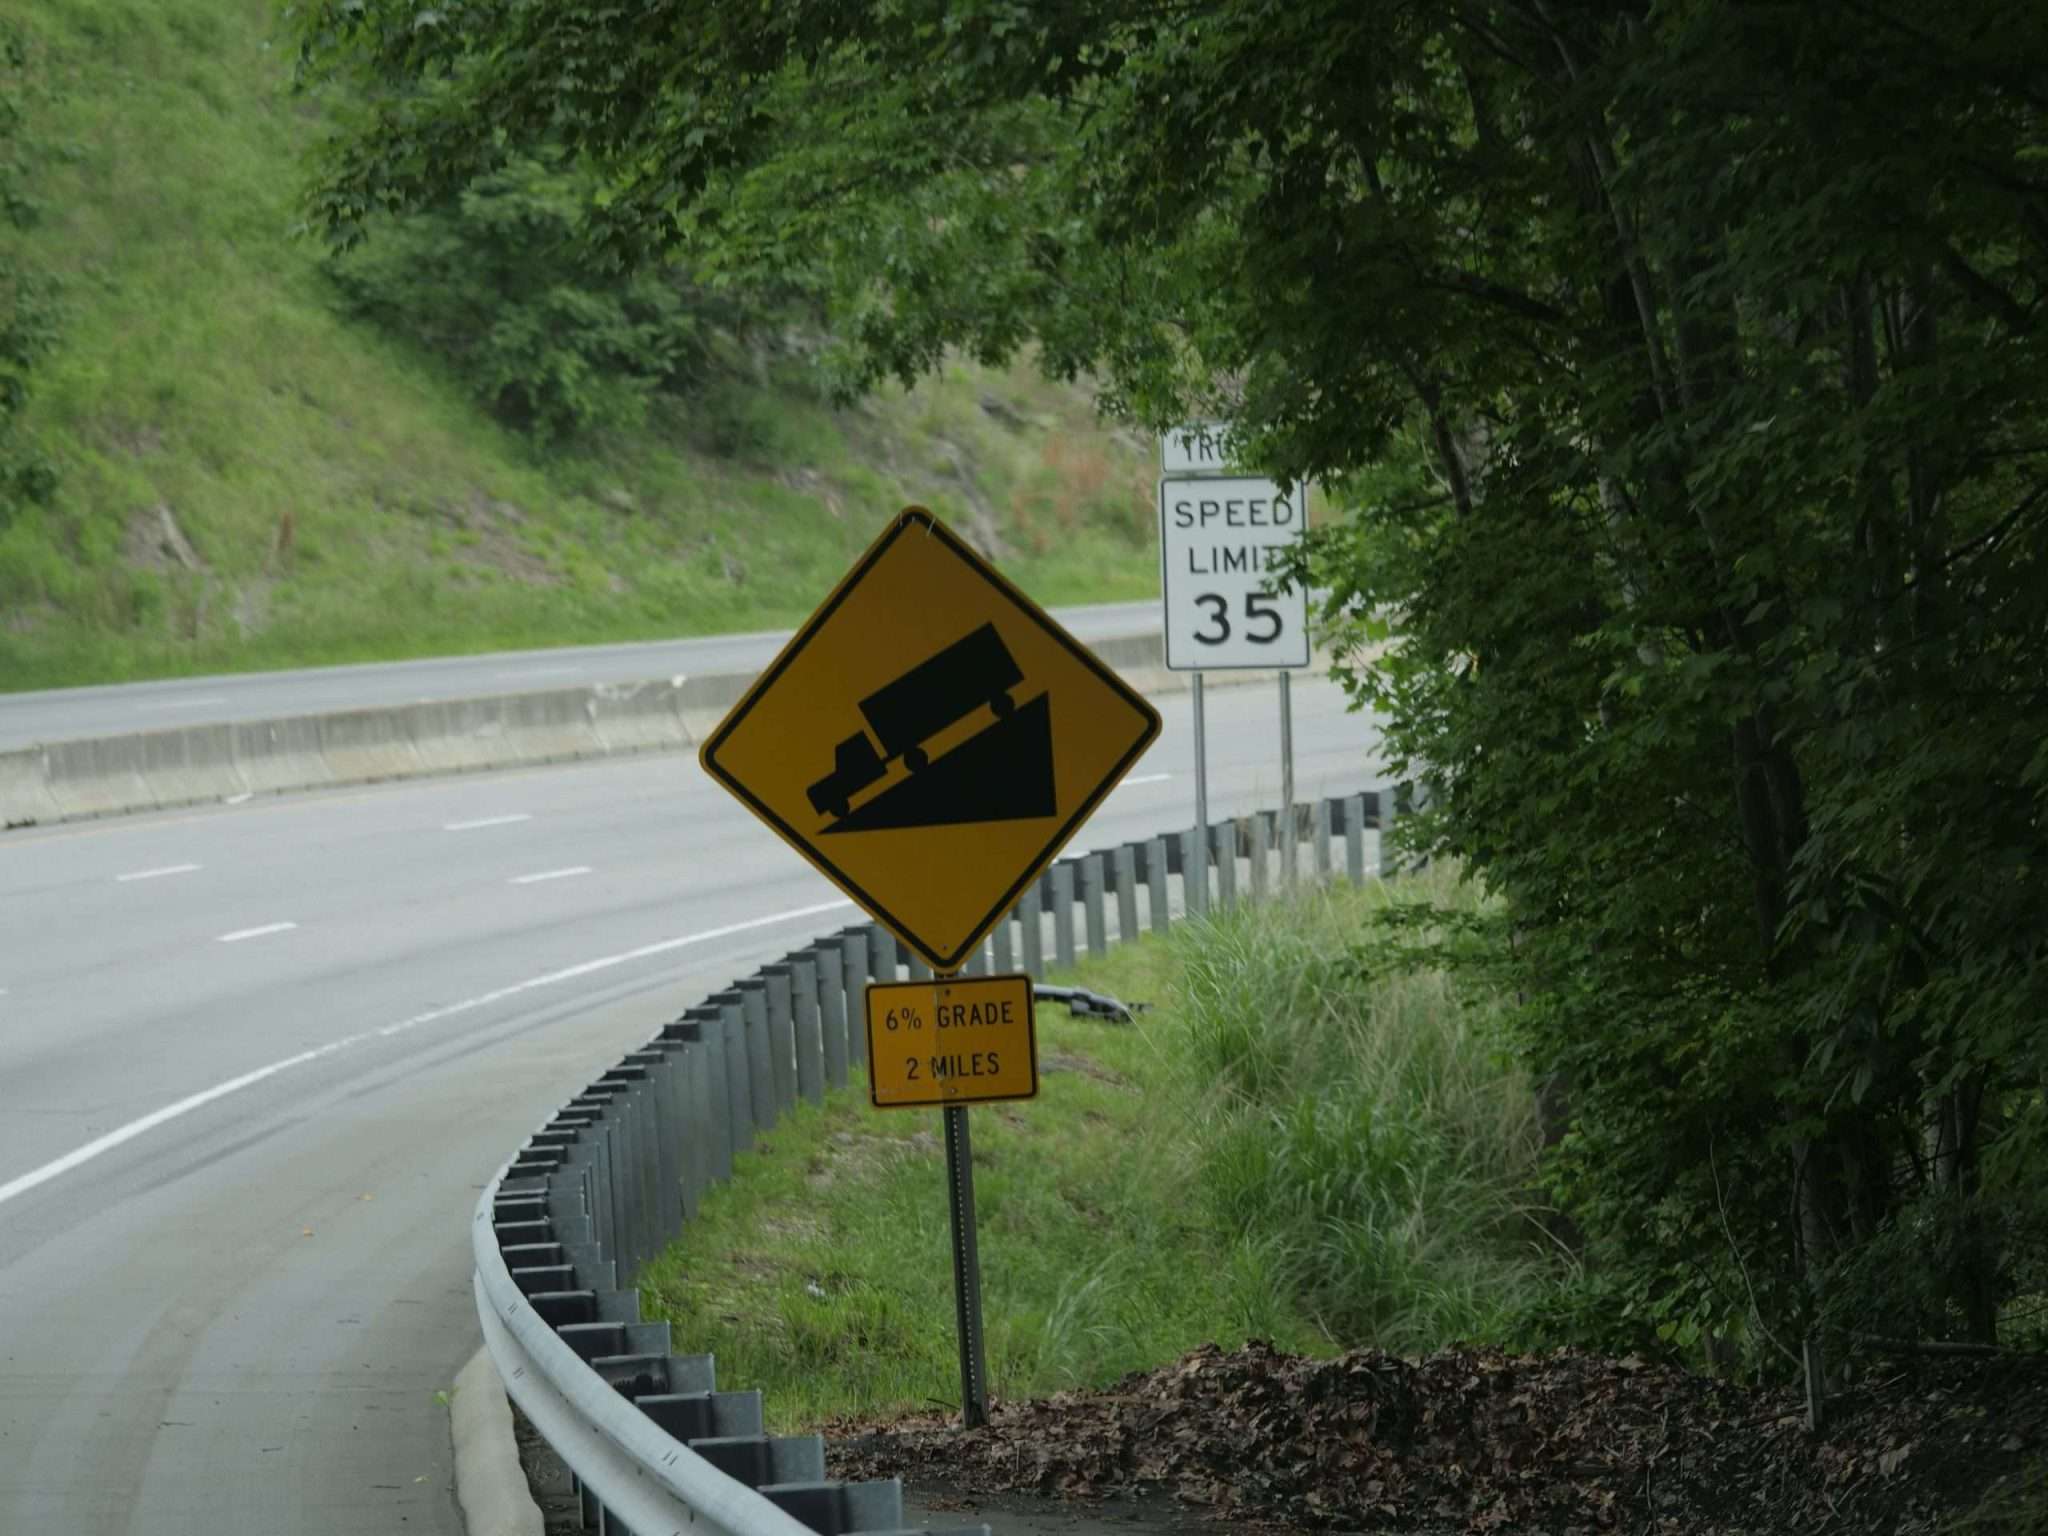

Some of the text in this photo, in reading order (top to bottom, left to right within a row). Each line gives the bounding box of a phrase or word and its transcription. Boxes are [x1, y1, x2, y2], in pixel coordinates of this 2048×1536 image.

[1175, 500, 1293, 528] SPEED
[1193, 593, 1283, 645] 35
[886, 1001, 1014, 1031] 6% GRADE
[906, 1052, 1000, 1080] 2 MILES
